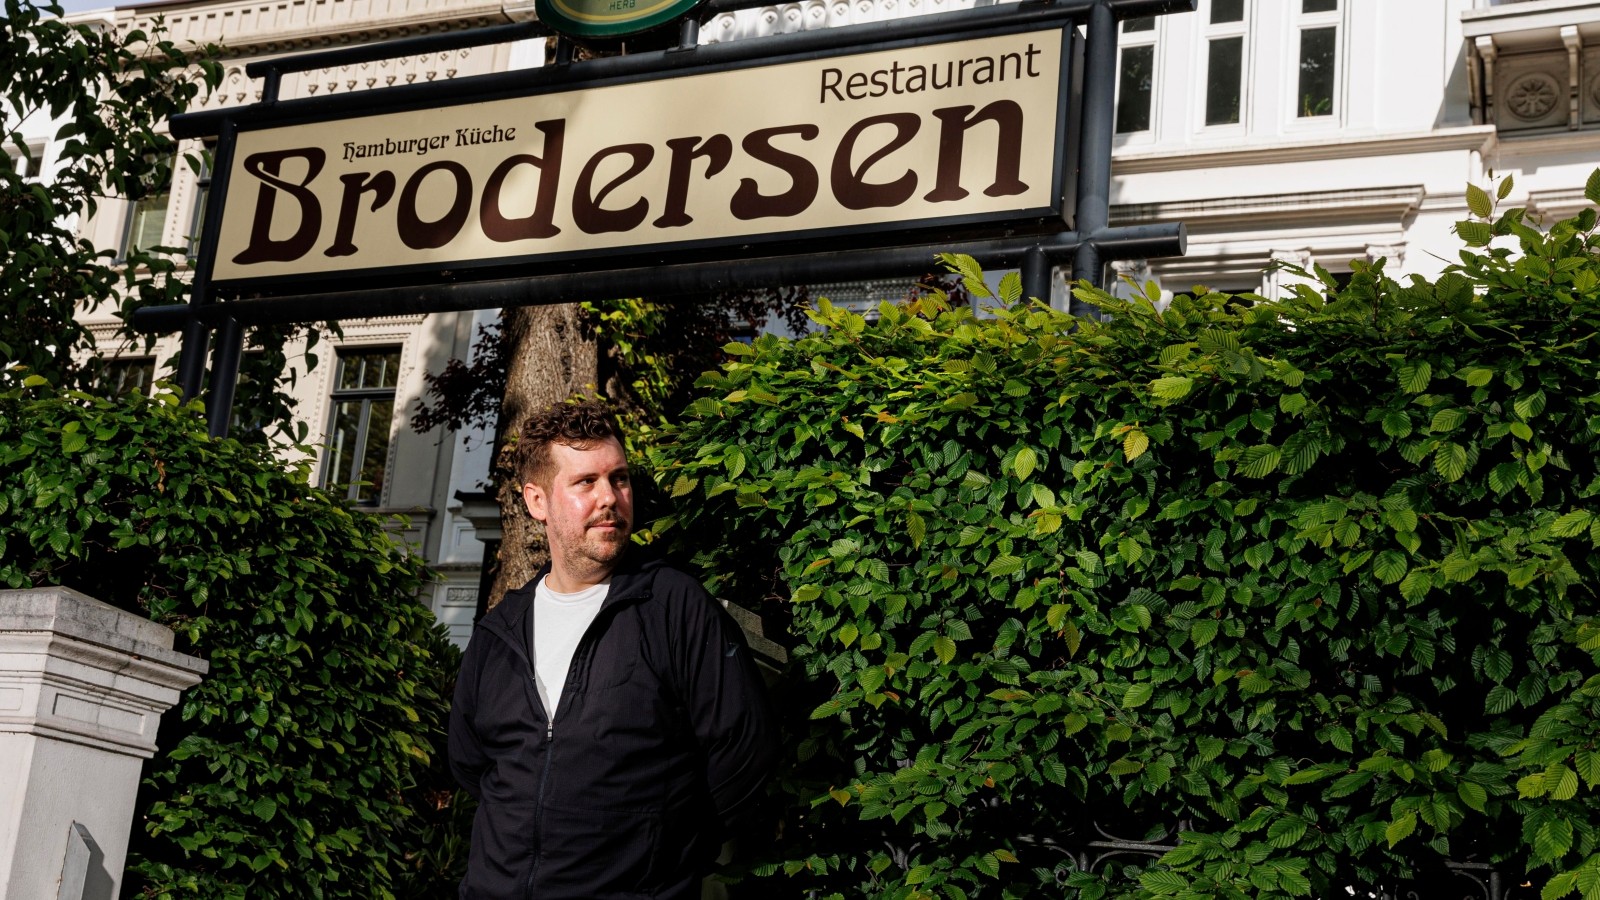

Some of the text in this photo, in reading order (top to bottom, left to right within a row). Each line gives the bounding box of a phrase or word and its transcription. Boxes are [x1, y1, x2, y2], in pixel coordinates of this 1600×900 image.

[609, 0, 636, 11] HERB
[819, 43, 1041, 104] Restaurant
[342, 124, 517, 162] Hamburger Küche
[231, 99, 1030, 265] Brodersen
